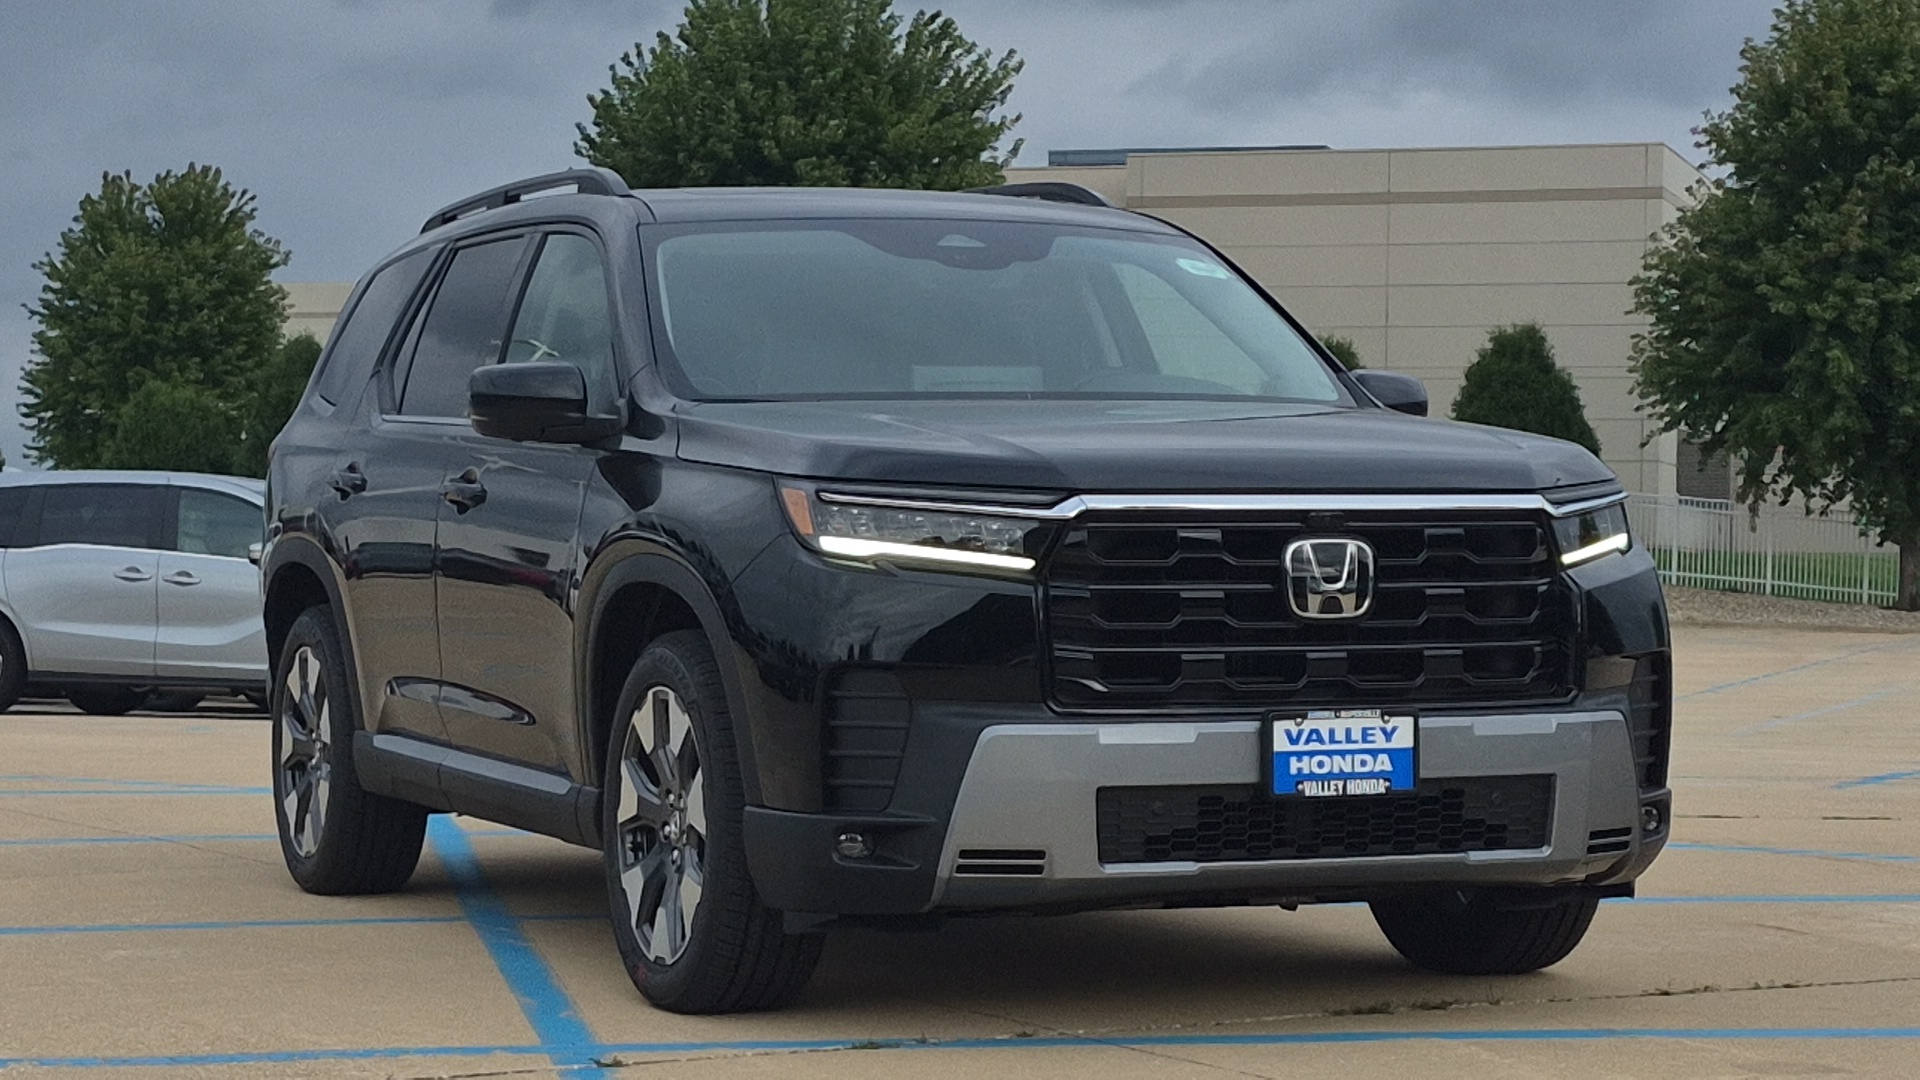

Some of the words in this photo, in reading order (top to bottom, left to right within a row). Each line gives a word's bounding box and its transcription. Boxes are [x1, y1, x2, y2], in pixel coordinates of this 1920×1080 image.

[1283, 725, 1400, 746] VALLEY
[1289, 753, 1393, 775] HONDA
[1303, 780, 1344, 797] VALLEY
[1346, 778, 1387, 795] HONDA
